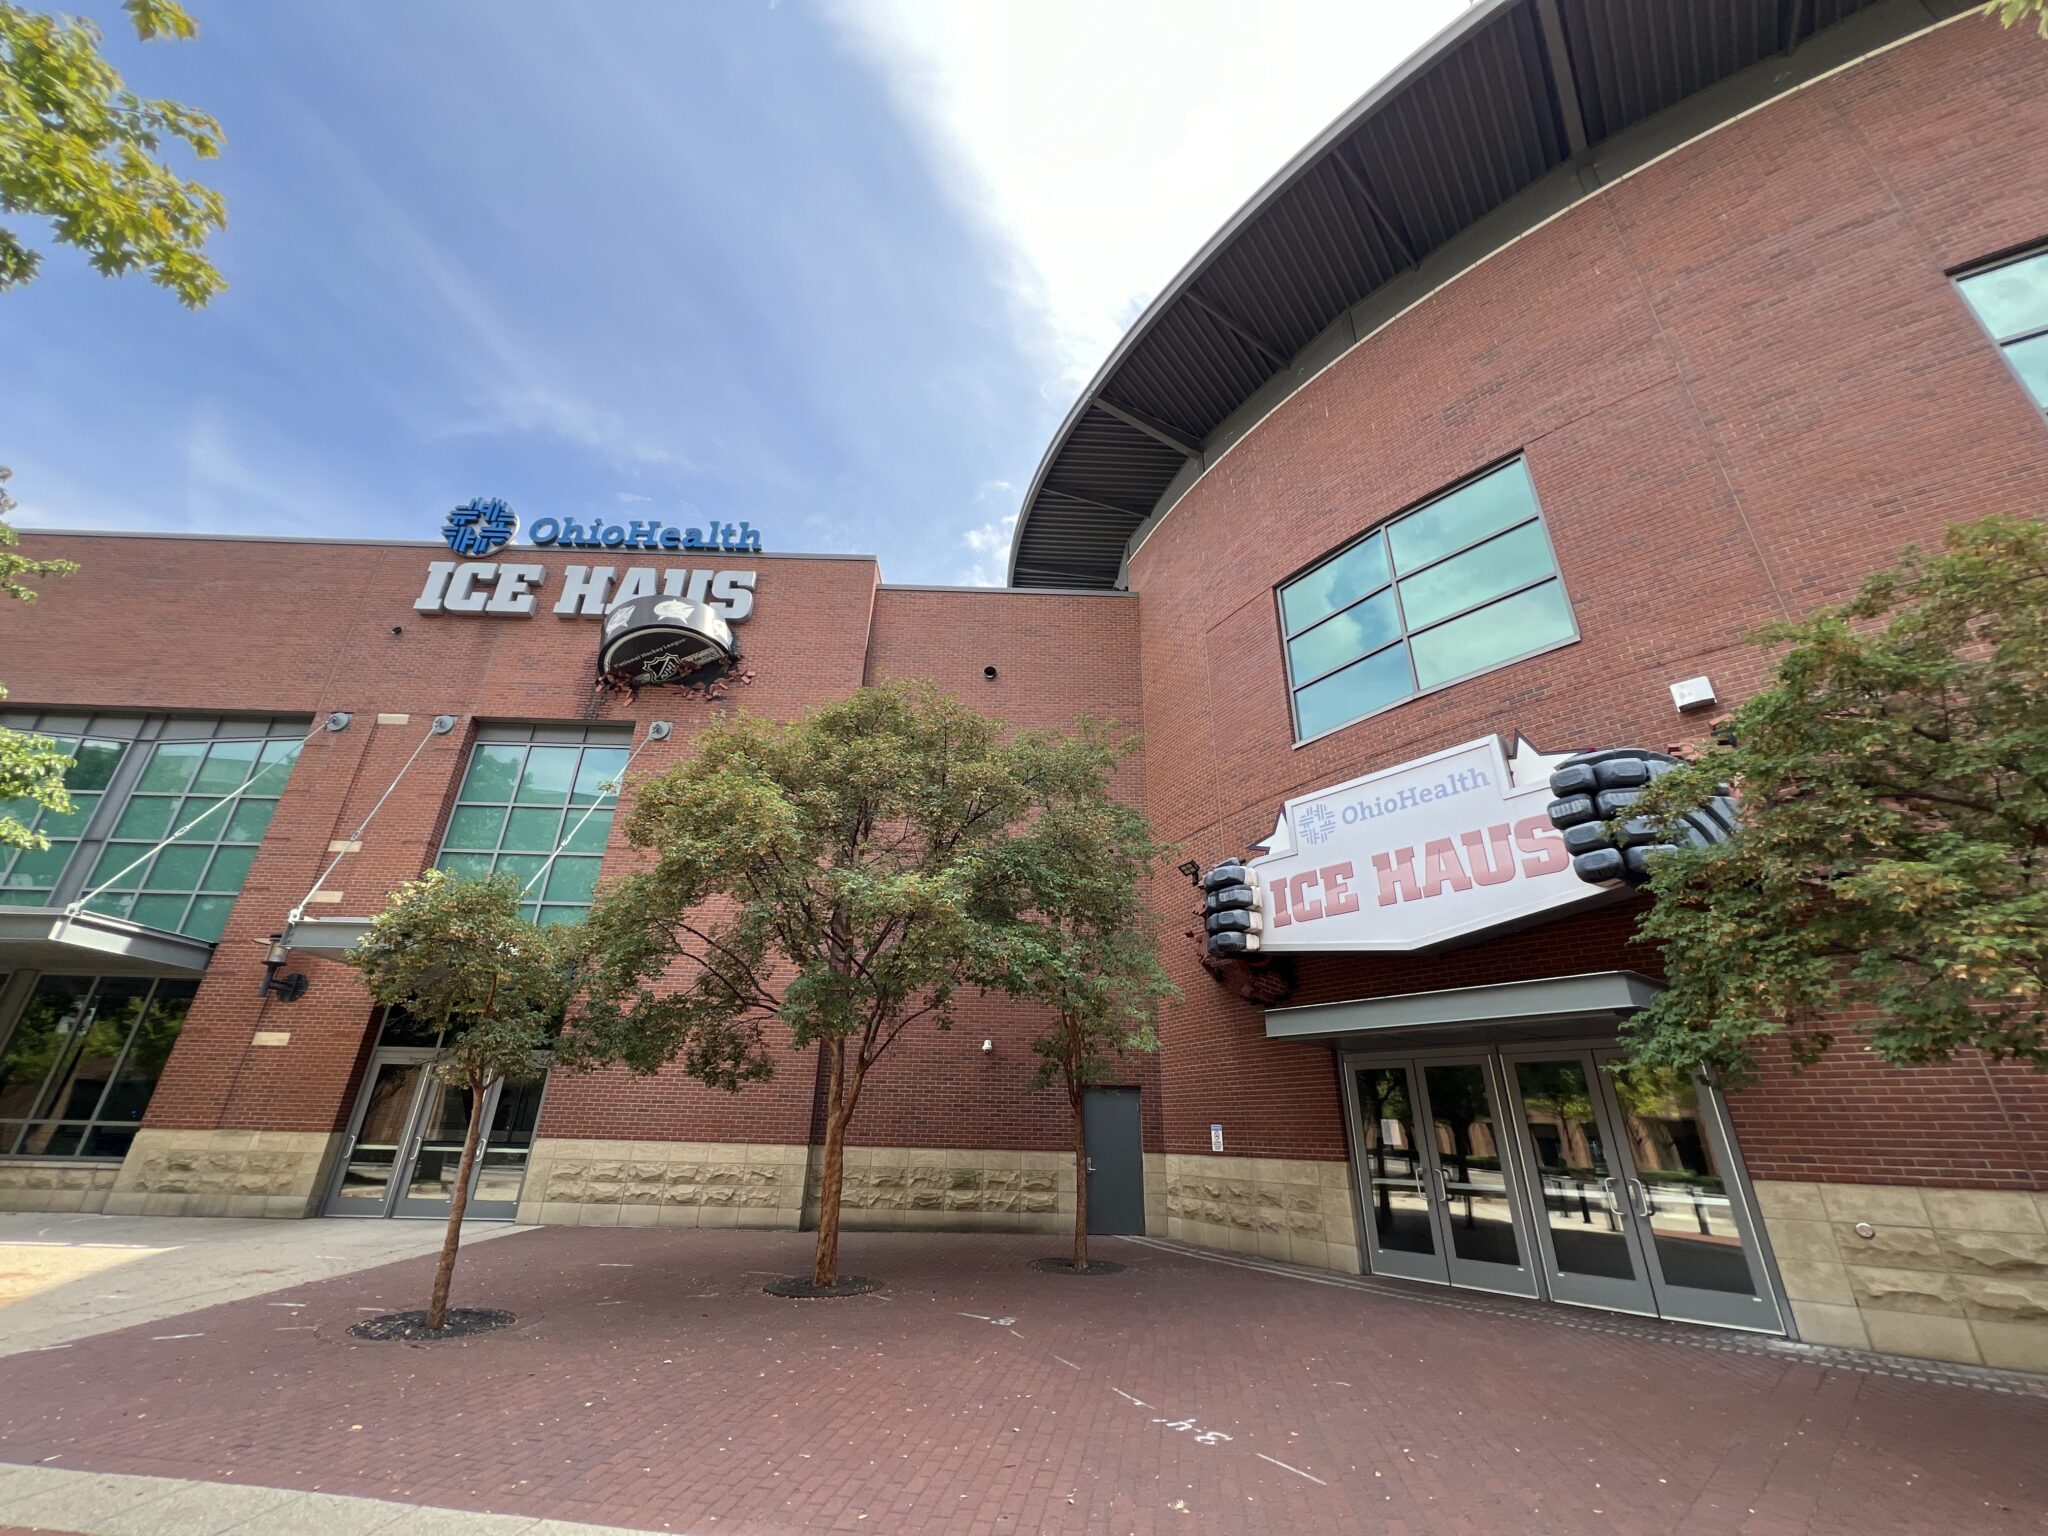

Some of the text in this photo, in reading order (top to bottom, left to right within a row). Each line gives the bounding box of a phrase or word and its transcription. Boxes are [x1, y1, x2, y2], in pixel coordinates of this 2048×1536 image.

[529, 517, 762, 553] OhioHealth
[413, 561, 546, 618] ICE
[641, 646, 663, 658] Hockey
[1342, 768, 1489, 824] OhioHealth
[1269, 813, 1569, 928] ICE HAUS
